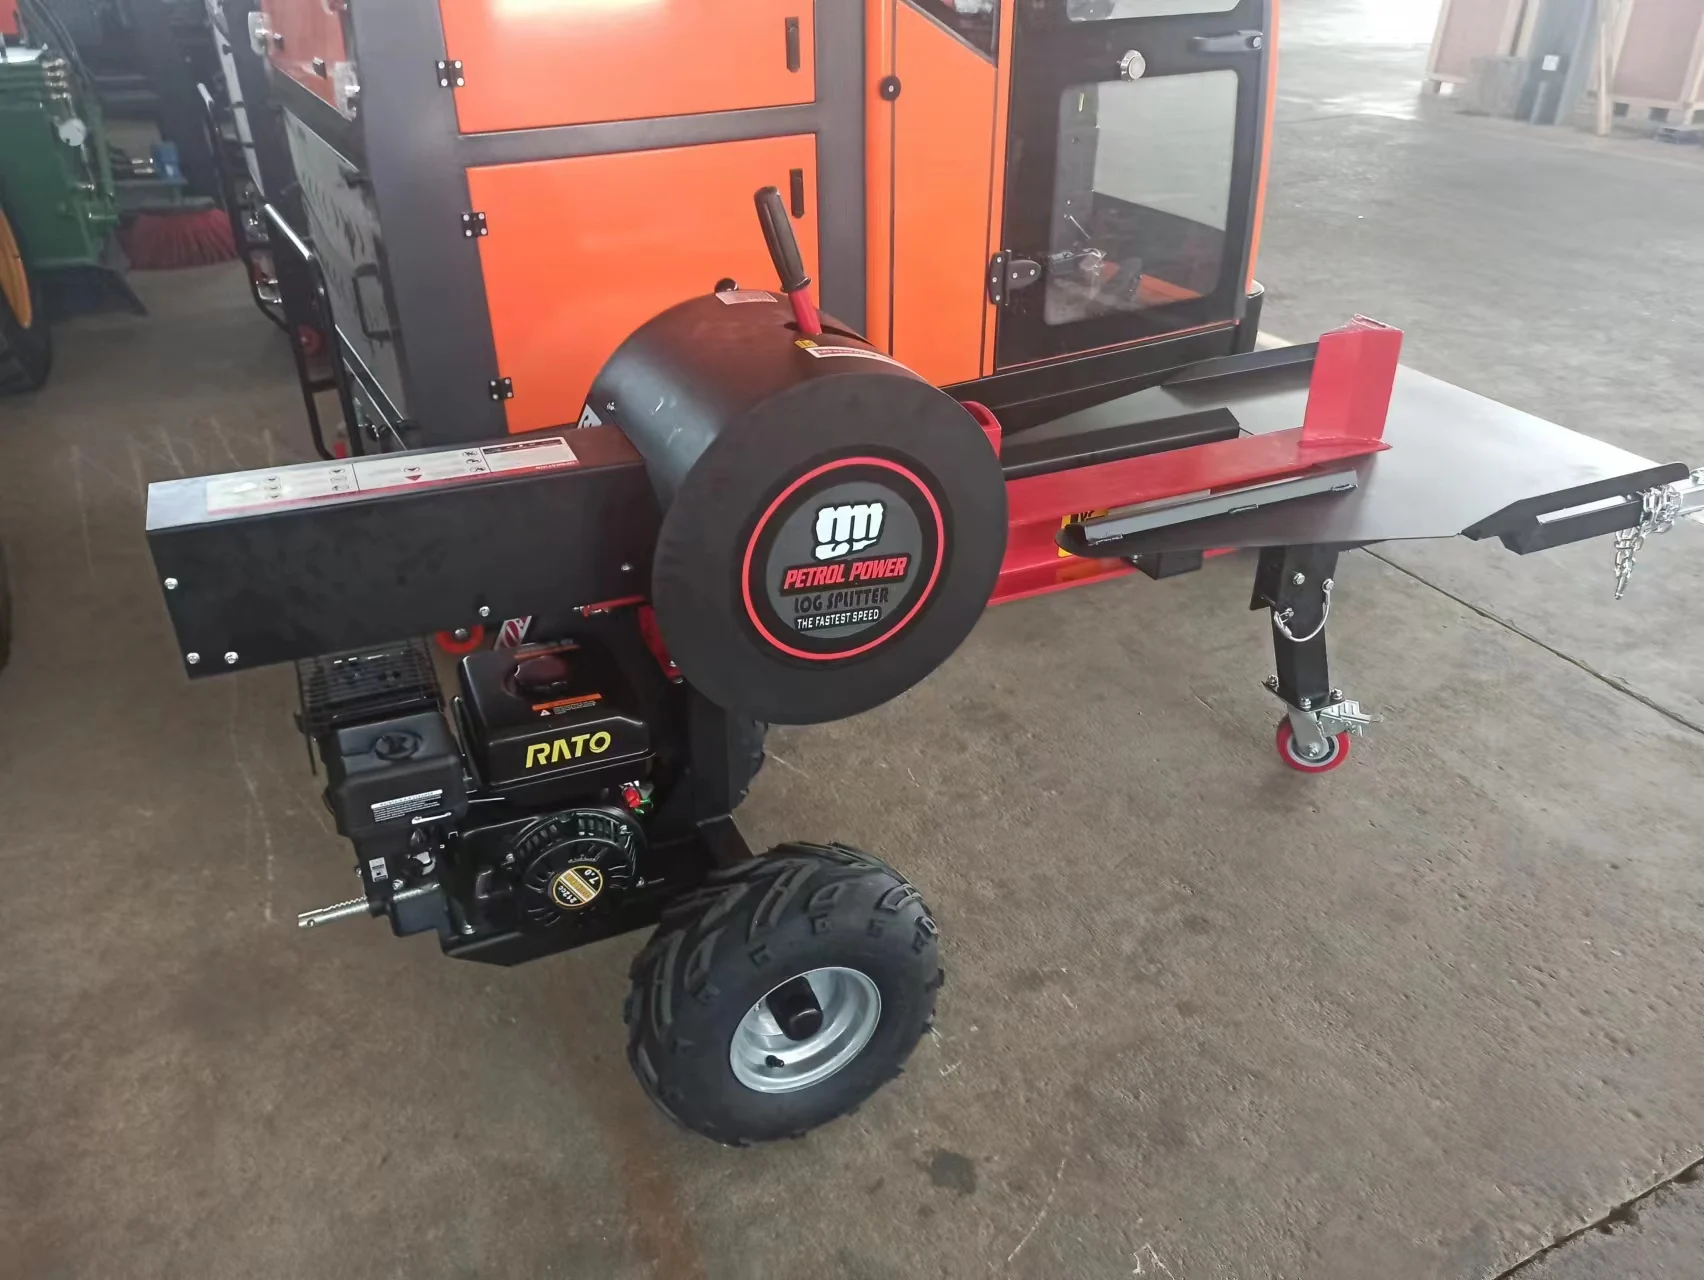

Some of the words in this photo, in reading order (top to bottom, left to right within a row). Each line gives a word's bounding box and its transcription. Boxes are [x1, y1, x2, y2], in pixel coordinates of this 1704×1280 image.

[783, 563, 845, 590] PETROL
[849, 556, 908, 581] POWER
[794, 594, 823, 613] LOG
[826, 586, 889, 609] SPLITTER
[796, 616, 813, 629] THE
[815, 612, 850, 627] FASTEST
[852, 608, 879, 623] SPEED
[525, 731, 611, 769] RATO
[584, 868, 599, 885] 7.0
[558, 885, 578, 904] 212cc
